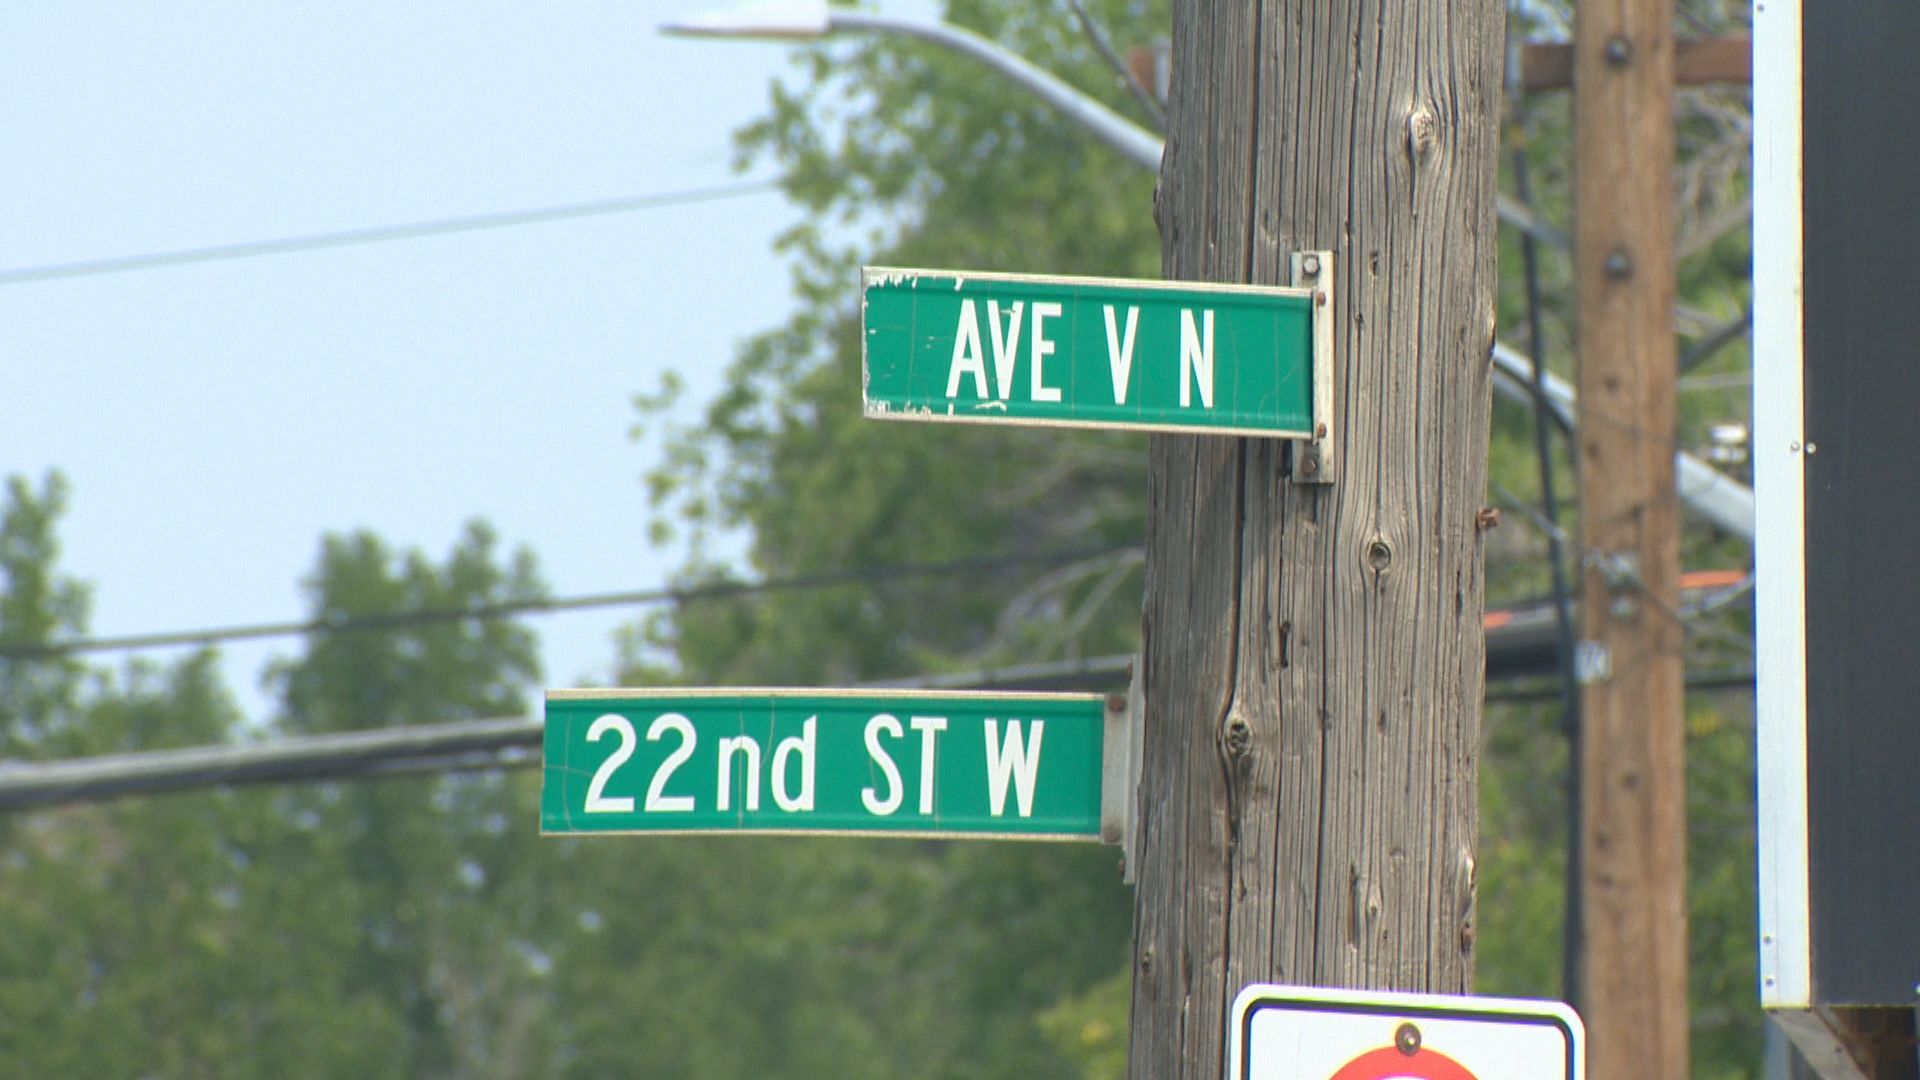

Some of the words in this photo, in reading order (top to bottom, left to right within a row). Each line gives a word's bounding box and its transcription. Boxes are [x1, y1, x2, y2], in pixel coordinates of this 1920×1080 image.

[945, 299, 1062, 402] AVE
[1103, 305, 1140, 405] V
[1179, 309, 1215, 409] N
[584, 713, 817, 813] 22nd
[861, 713, 948, 816] ST
[984, 718, 1044, 818] W
